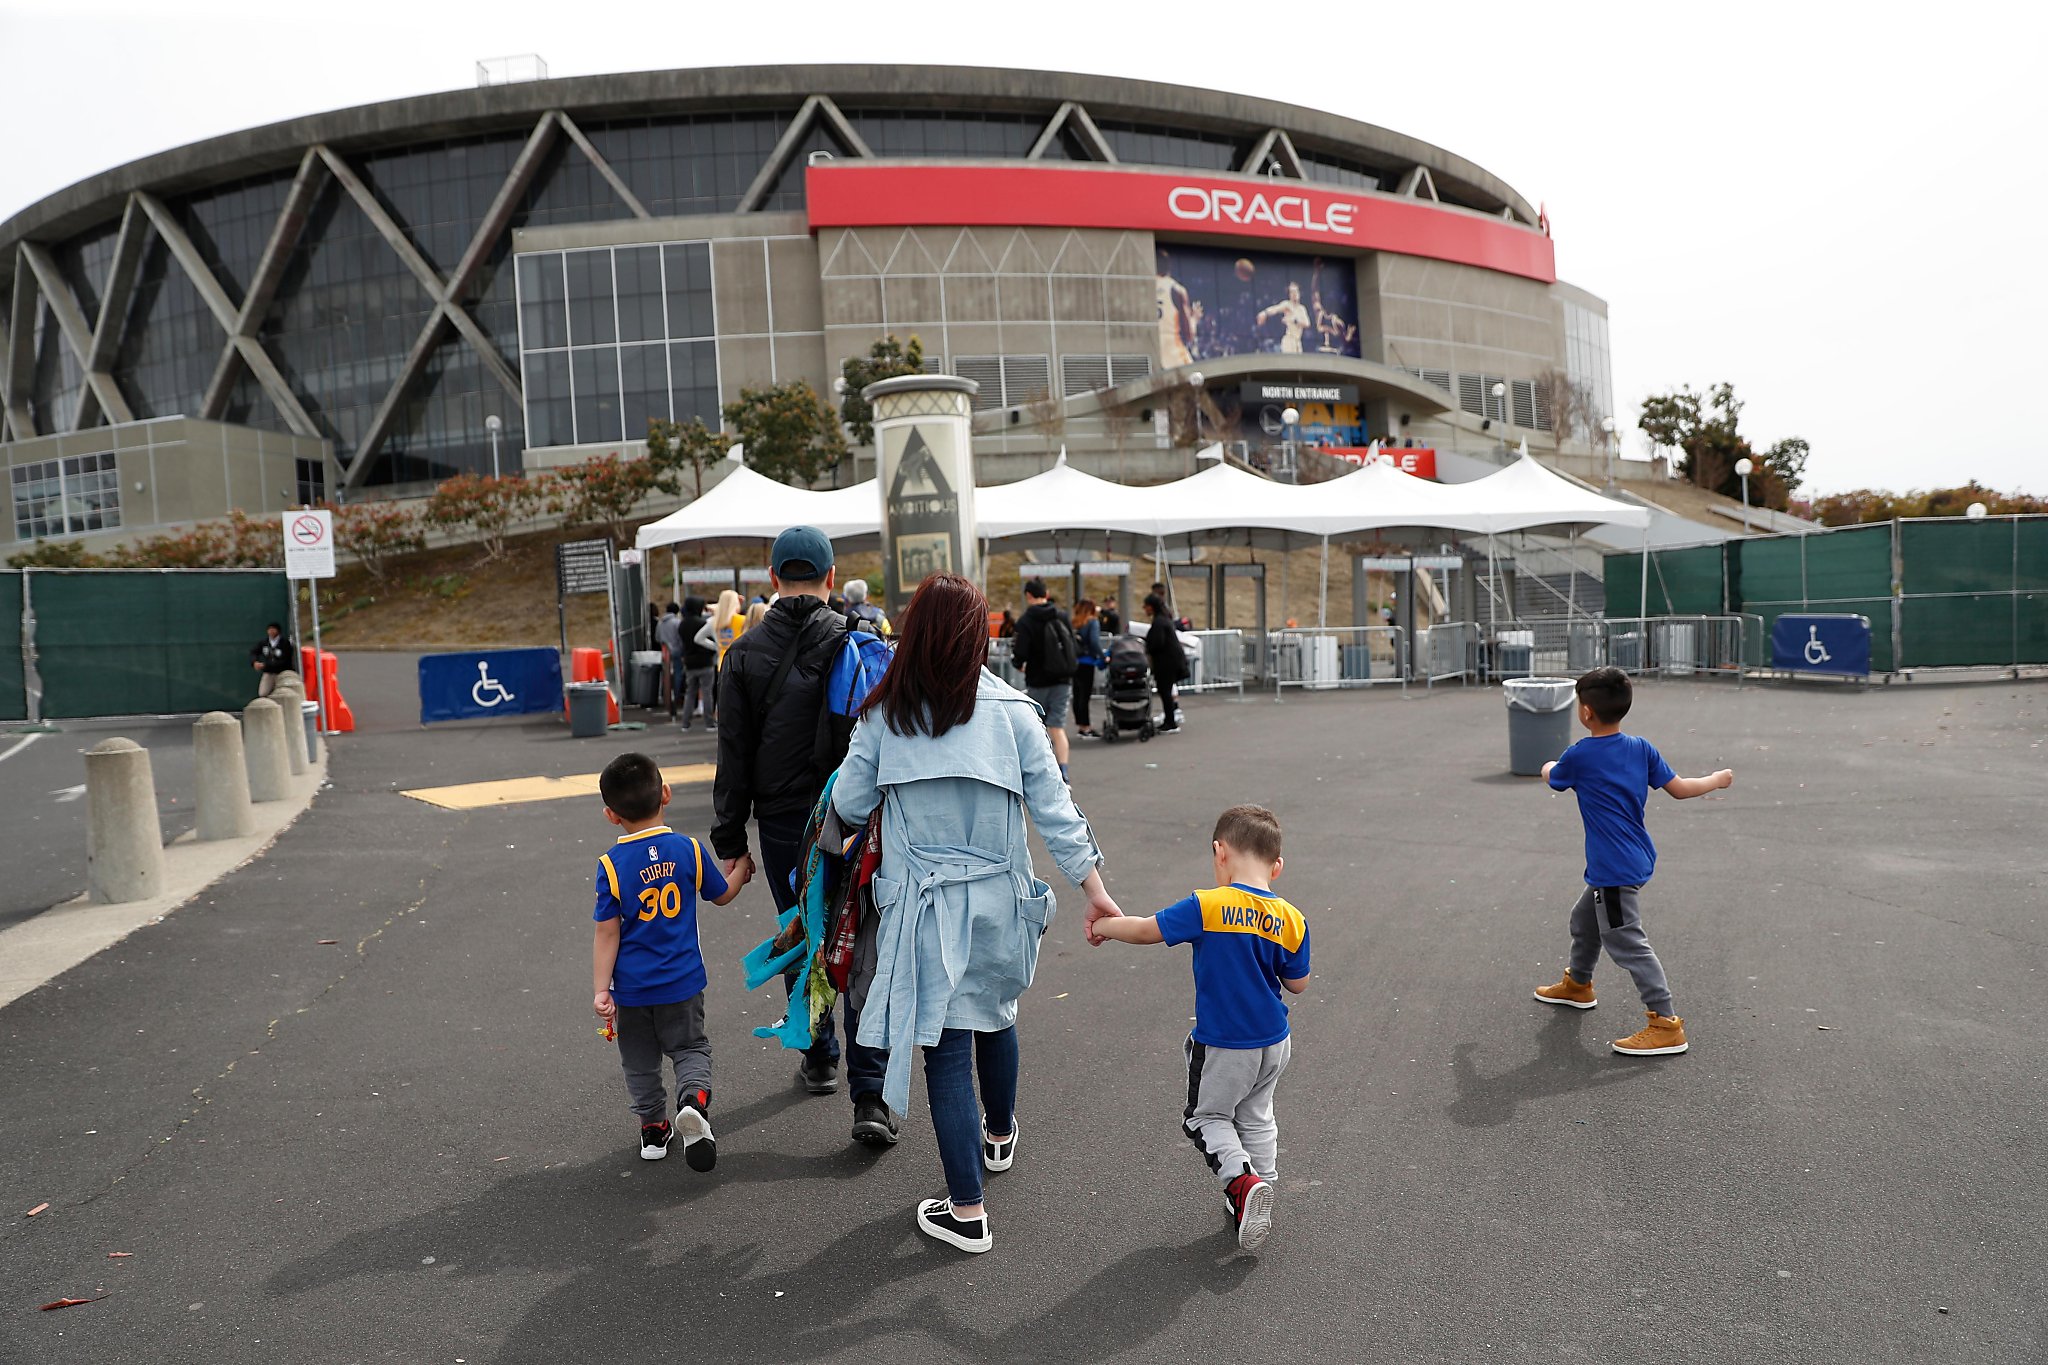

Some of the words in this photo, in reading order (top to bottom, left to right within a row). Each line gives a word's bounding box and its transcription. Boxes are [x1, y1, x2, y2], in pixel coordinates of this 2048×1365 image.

[1167, 186, 1355, 235] ORACLE
[1261, 386, 1294, 399] NORTH
[1294, 387, 1341, 400] ENTRANCE
[639, 861, 676, 884] CURRY
[637, 881, 681, 922] 30
